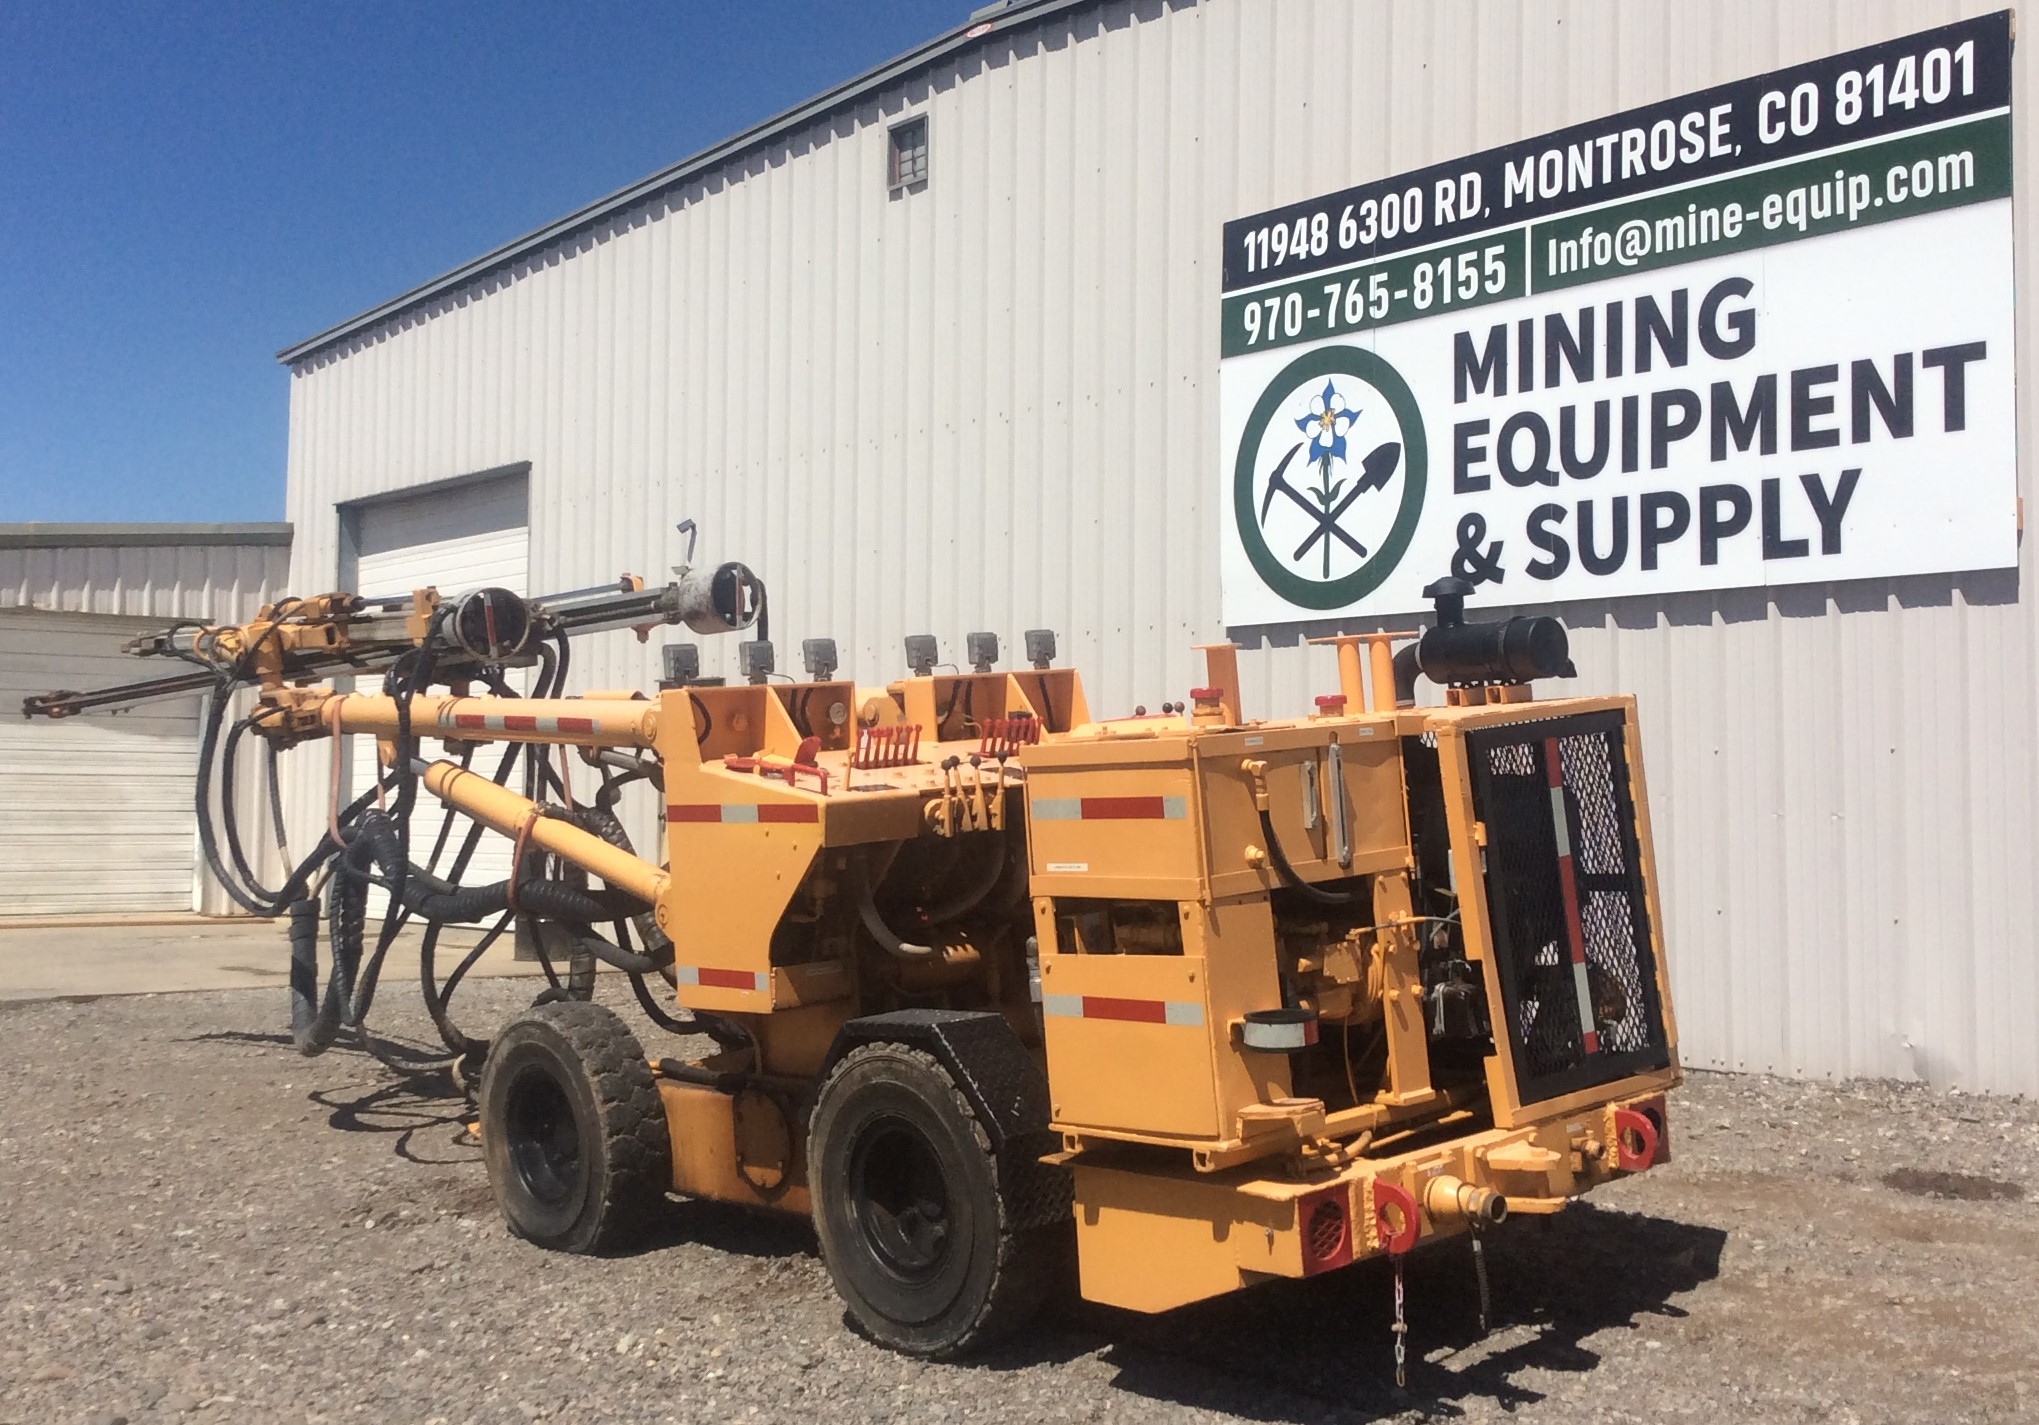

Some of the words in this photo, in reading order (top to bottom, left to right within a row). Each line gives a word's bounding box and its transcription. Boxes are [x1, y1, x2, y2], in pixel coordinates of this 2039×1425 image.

[1243, 212, 1329, 273] 11948
[1338, 186, 1423, 250] 6300
[1434, 171, 1491, 227] RD,
[1504, 102, 1742, 209] MONTROSE,
[1758, 82, 1819, 145] CO
[1835, 39, 1975, 126] 81401
[1548, 150, 1975, 277] Info@mine-equip.com
[1243, 244, 1506, 346] 970-765-8155
[1453, 277, 1757, 404] MINING
[1453, 340, 1987, 495] EQUIPMENT
[1450, 511, 1506, 587] &
[1524, 468, 1862, 581] SUPPLY
